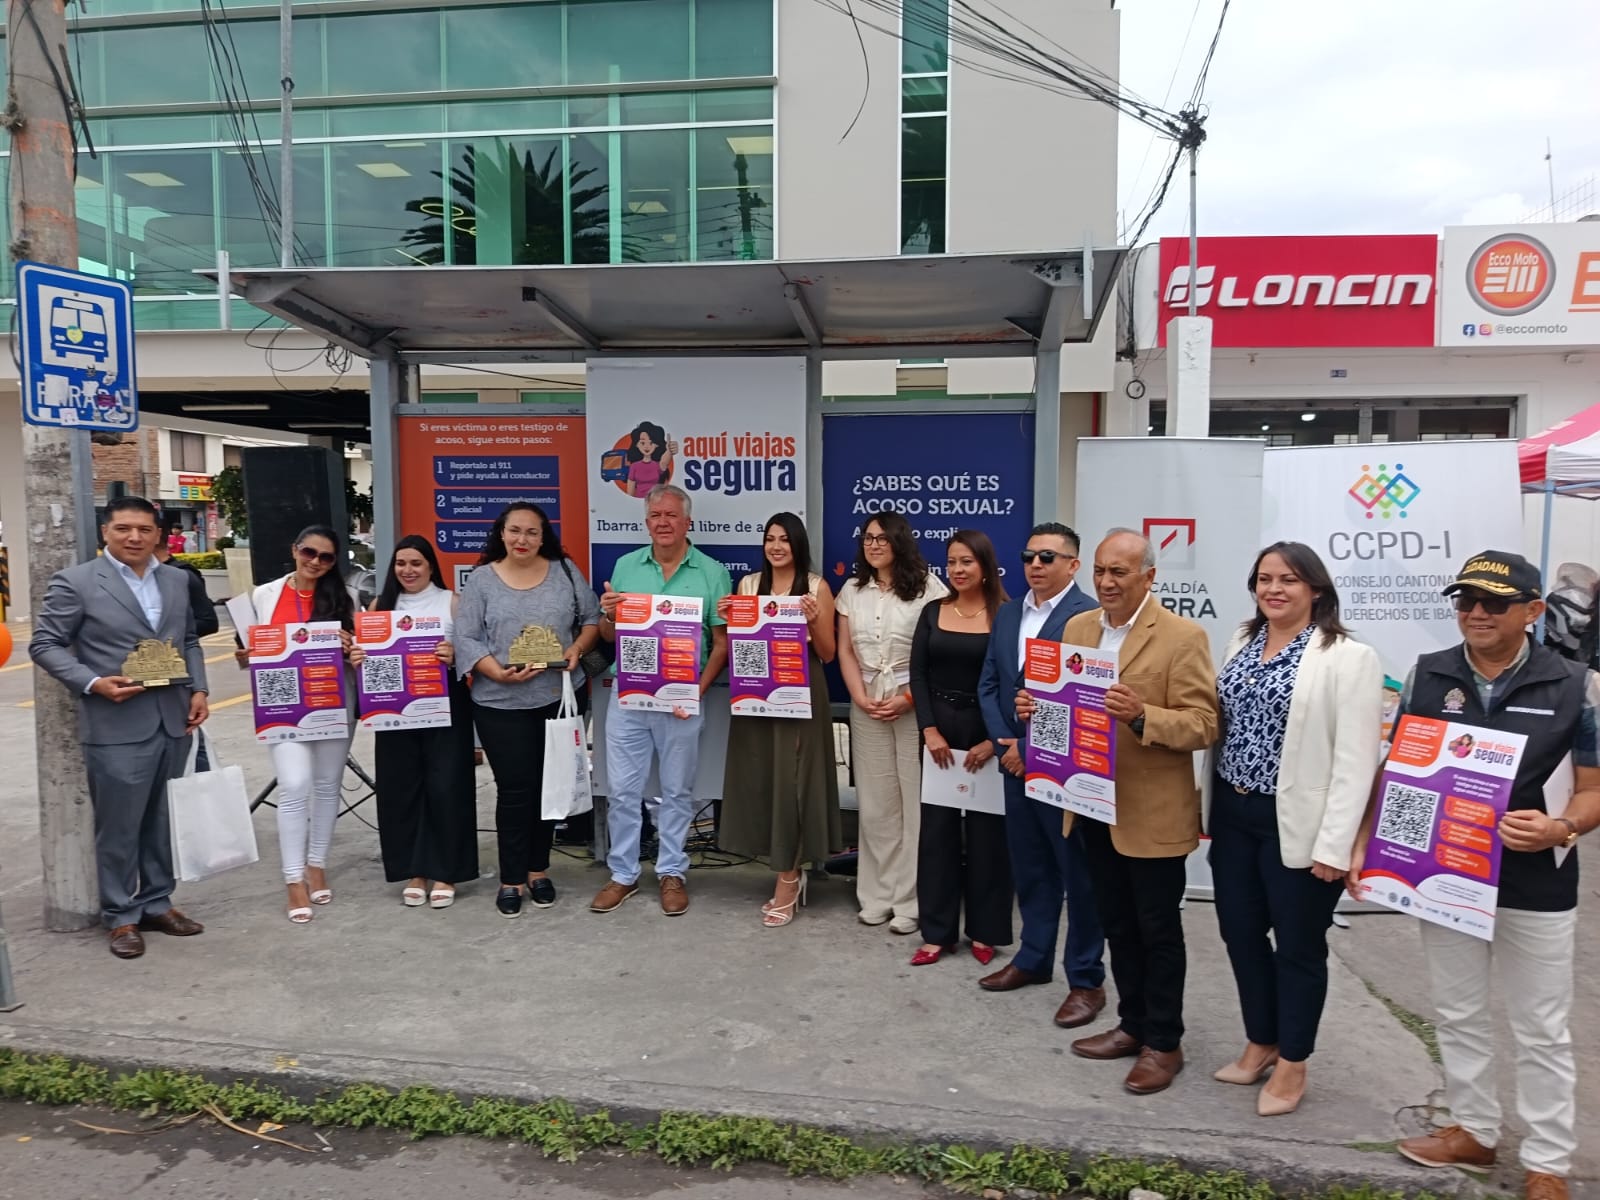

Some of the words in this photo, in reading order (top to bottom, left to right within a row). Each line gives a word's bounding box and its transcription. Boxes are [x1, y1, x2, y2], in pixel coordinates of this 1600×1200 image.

[1489, 252, 1511, 266] Ecco
[1512, 252, 1539, 265] Moto
[1218, 274, 1433, 306] LONCIN
[1496, 324, 1568, 334] @eccomoto
[419, 423, 429, 432] Si
[452, 423, 487, 432] víctima
[499, 424, 518, 432] eres
[521, 423, 553, 434] testigo
[556, 423, 569, 432] de
[435, 437, 466, 445] acoso,
[468, 436, 493, 446] sigue
[495, 436, 520, 444] estos
[523, 437, 552, 445] pasos:
[683, 431, 727, 460] aquí
[733, 431, 795, 460] viajas
[437, 461, 444, 474] 1
[475, 472, 499, 480] ayuda
[684, 459, 796, 496] segura
[853, 475, 922, 495] ¿SABES
[927, 472, 971, 492] QUÉ
[976, 475, 999, 491] ES
[437, 495, 446, 507] 2
[852, 499, 923, 515] ACOSO
[928, 499, 1014, 515] SEXUAL?
[597, 520, 642, 532] Ibarra:
[699, 520, 733, 532] libre
[735, 521, 752, 532] de
[438, 530, 447, 543] 3
[1329, 531, 1452, 560] CCPD-I
[1150, 581, 1208, 594] CALDÍA
[1334, 575, 1391, 588] CONSEJO
[1395, 575, 1457, 588] CANTONA
[1352, 592, 1367, 604] DE
[1161, 598, 1217, 619] RRA
[1344, 608, 1409, 620] DERECHOS
[1413, 608, 1431, 620] DE
[1085, 665, 1114, 680] segura
[1474, 748, 1514, 766] segura
